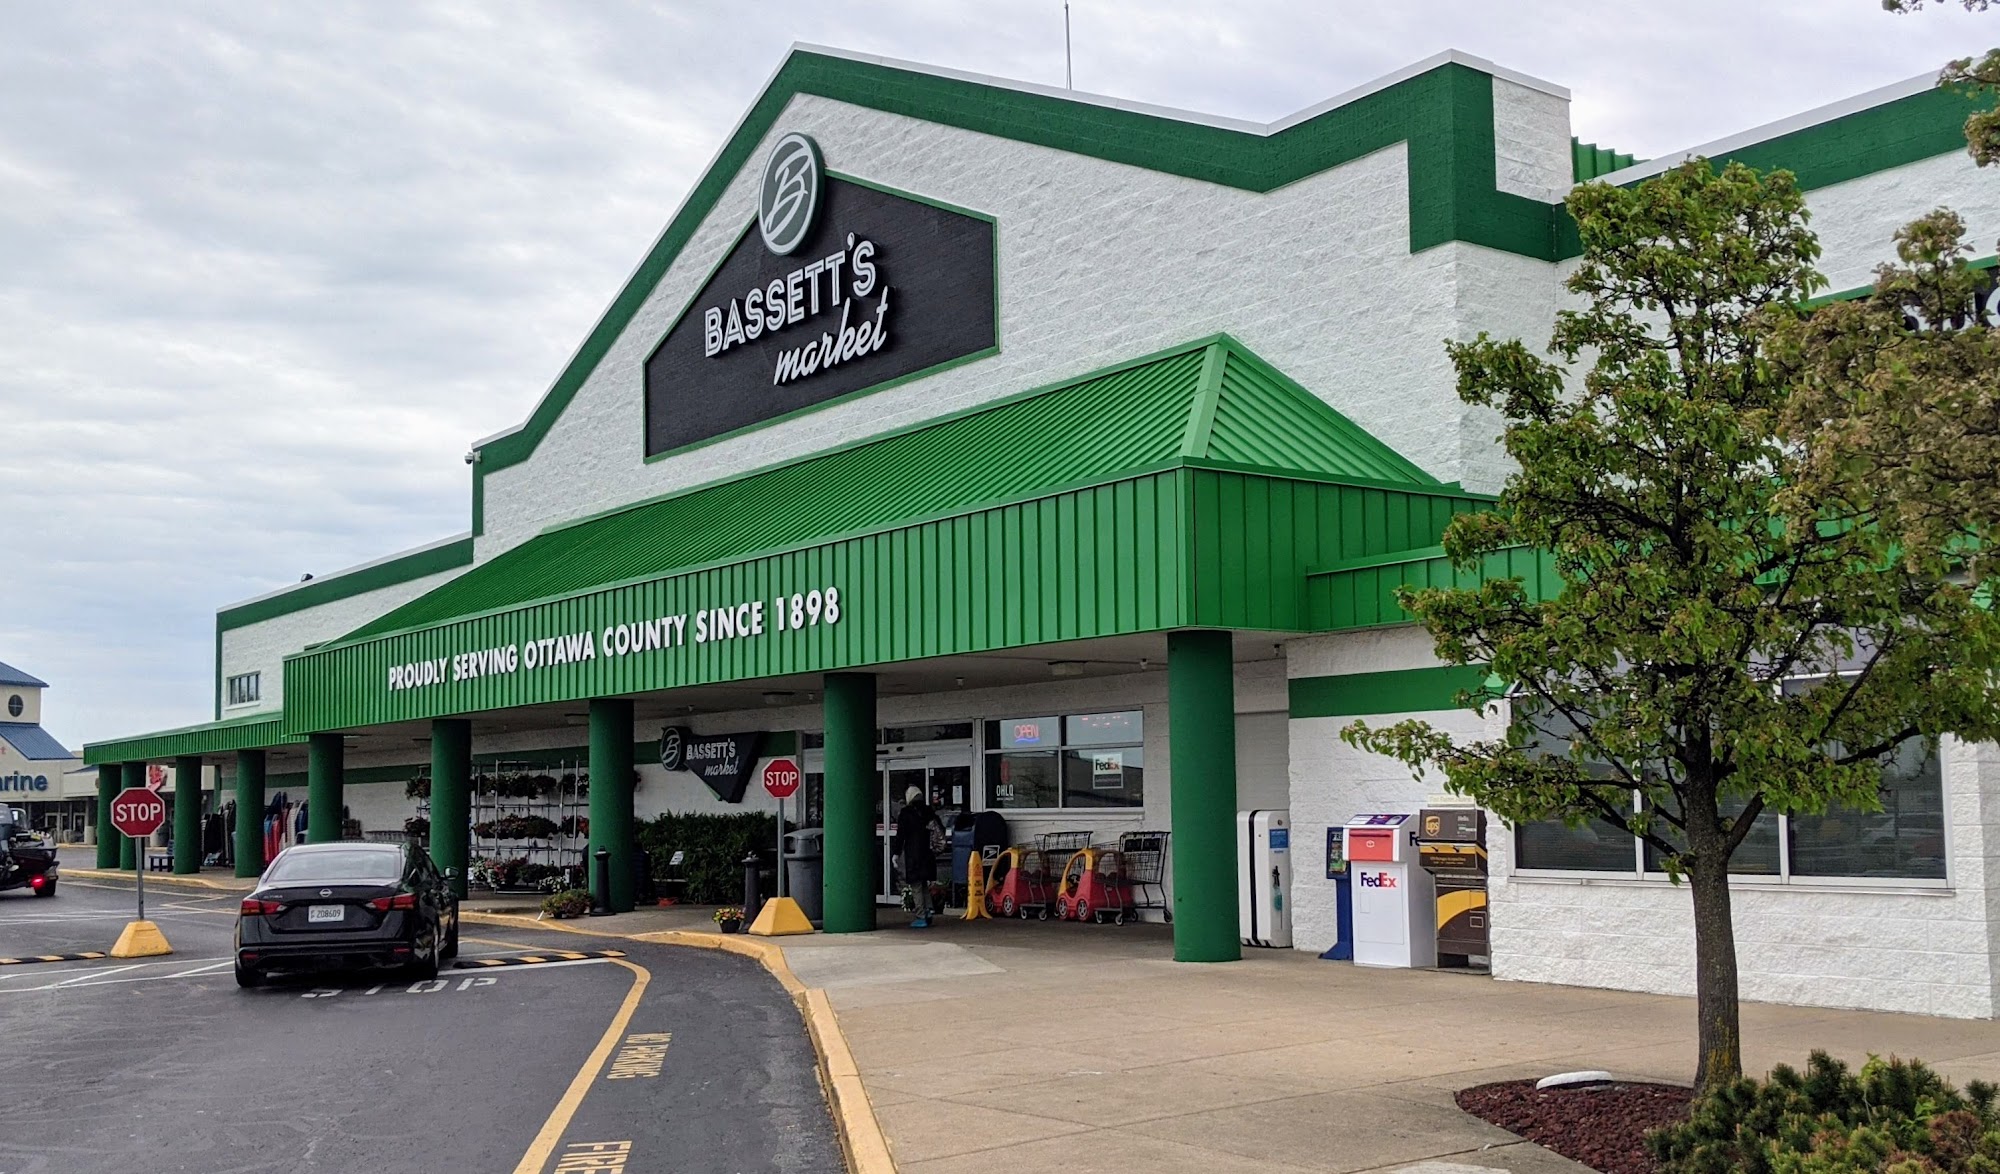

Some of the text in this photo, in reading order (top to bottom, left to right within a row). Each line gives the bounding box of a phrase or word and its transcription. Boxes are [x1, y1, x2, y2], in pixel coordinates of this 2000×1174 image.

[705, 232, 877, 358] BASSETT'S
[774, 286, 889, 386] market
[389, 586, 839, 691] PROUDLY SERVING OTTAWA COUNTY SINCE 1898
[1014, 724, 1039, 738] OPEN
[686, 738, 736, 760] BASSETT'S
[704, 755, 739, 776] market
[1095, 757, 1120, 771] FedEx
[766, 771, 798, 786] STOP
[996, 784, 1014, 797] OHLQ
[116, 803, 161, 822] STOP
[1360, 872, 1397, 888] FedEx
